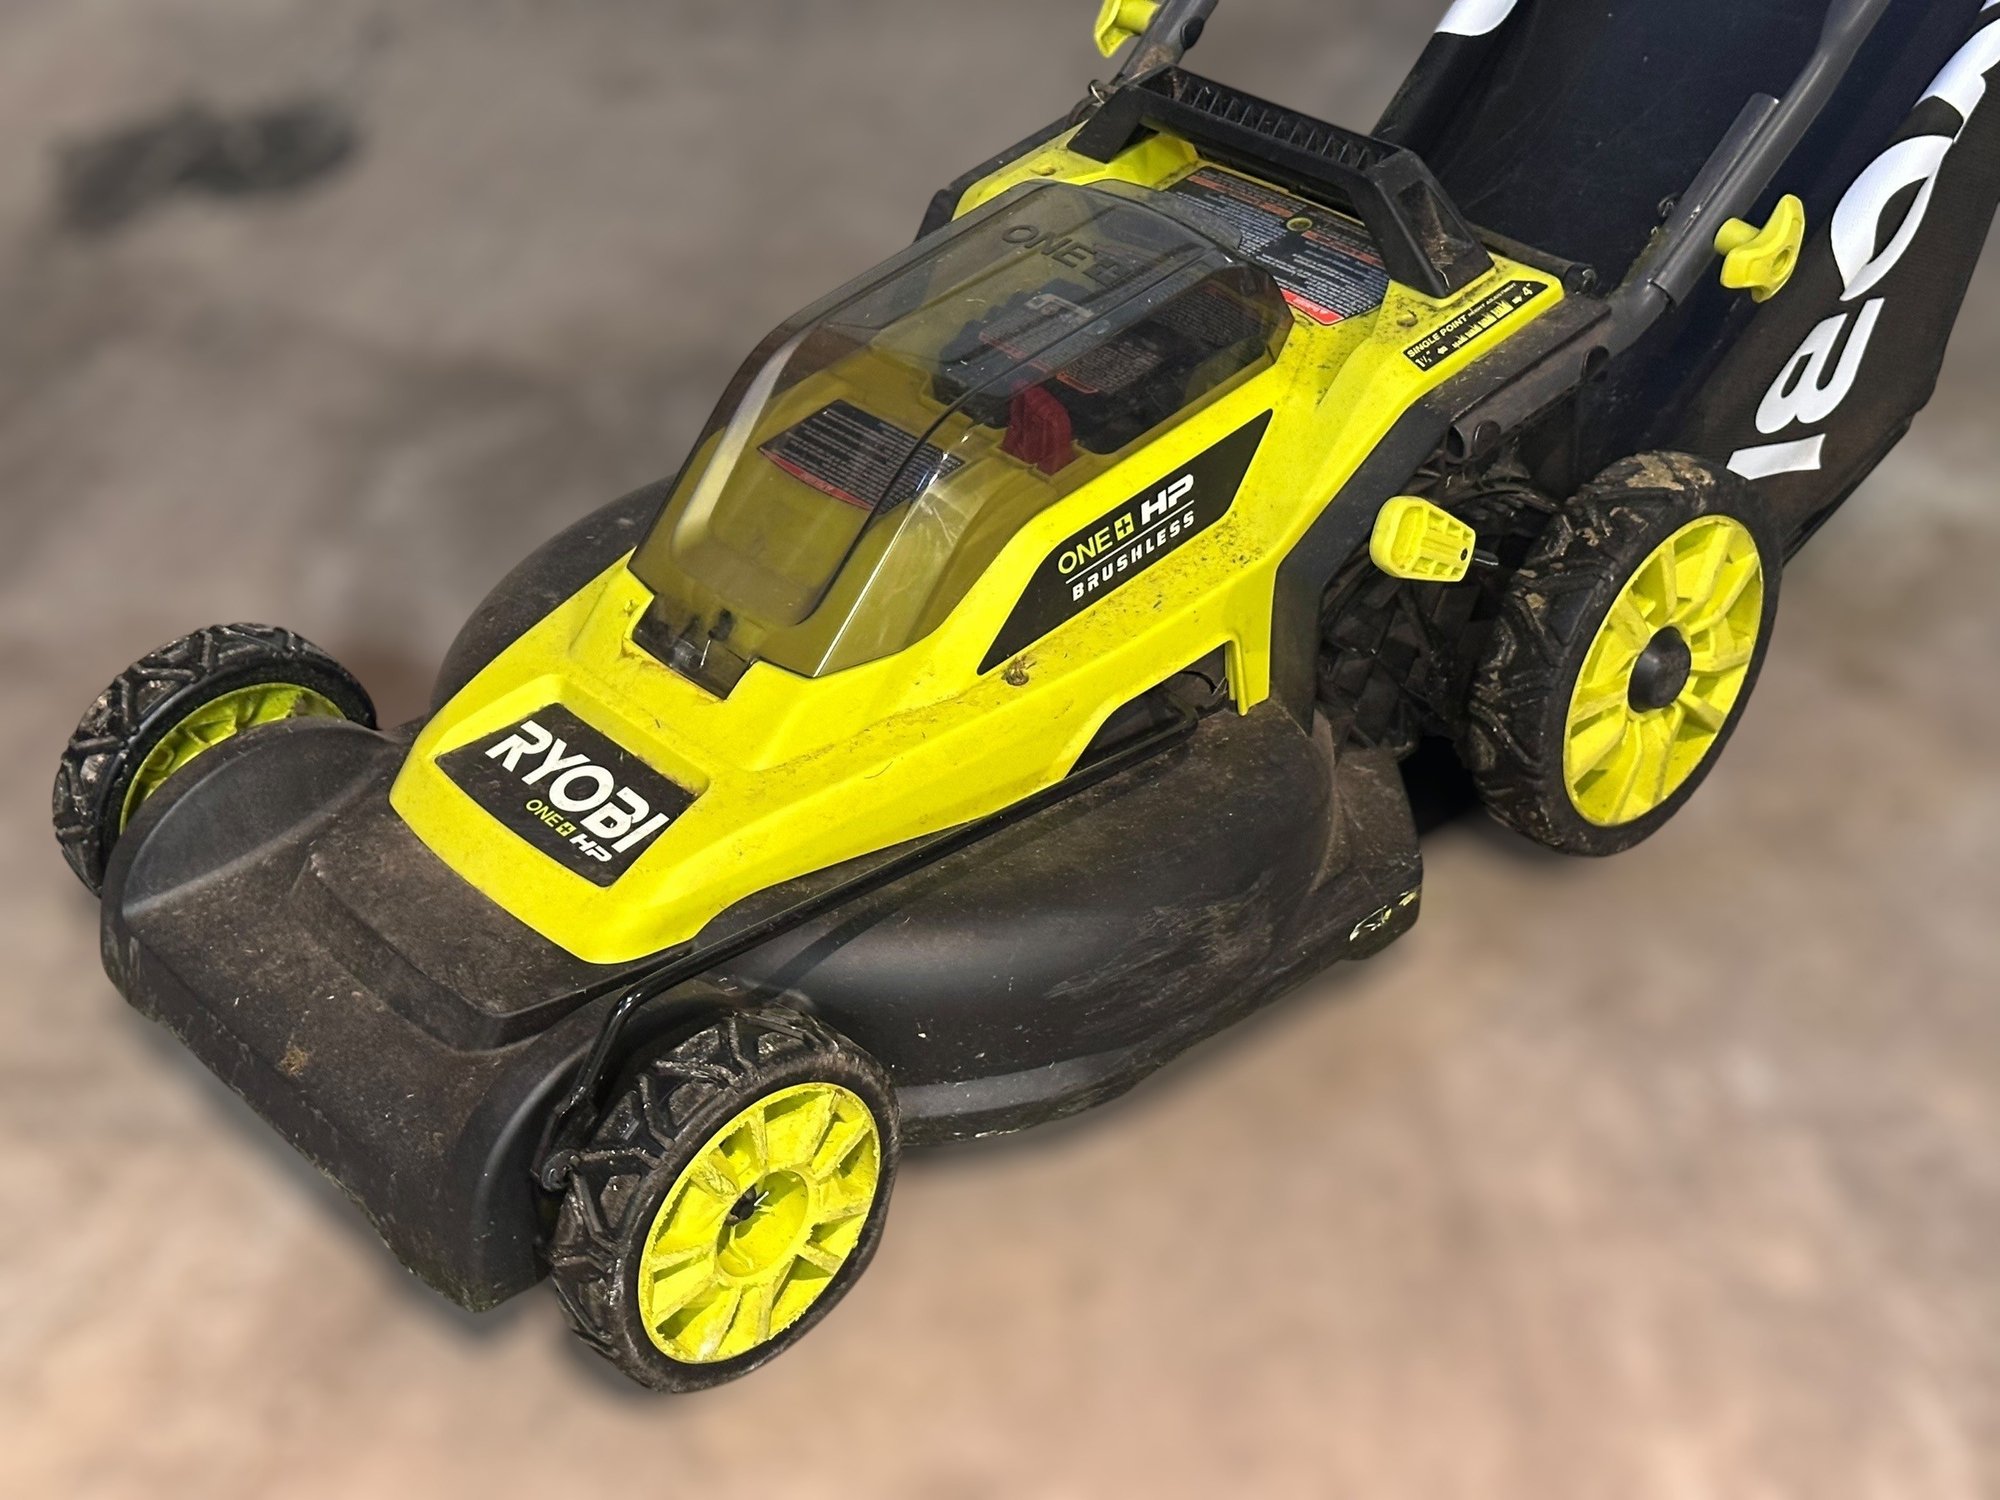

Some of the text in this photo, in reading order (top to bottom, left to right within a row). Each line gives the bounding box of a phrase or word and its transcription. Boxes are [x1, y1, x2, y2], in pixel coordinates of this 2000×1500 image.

[1406, 332, 1441, 358] SINGLE
[1439, 314, 1468, 337] POINT
[1140, 473, 1195, 526] HP
[1072, 510, 1195, 602] BRUSHLESS
[484, 719, 670, 854] RYOBI
[569, 833, 613, 862] HP
